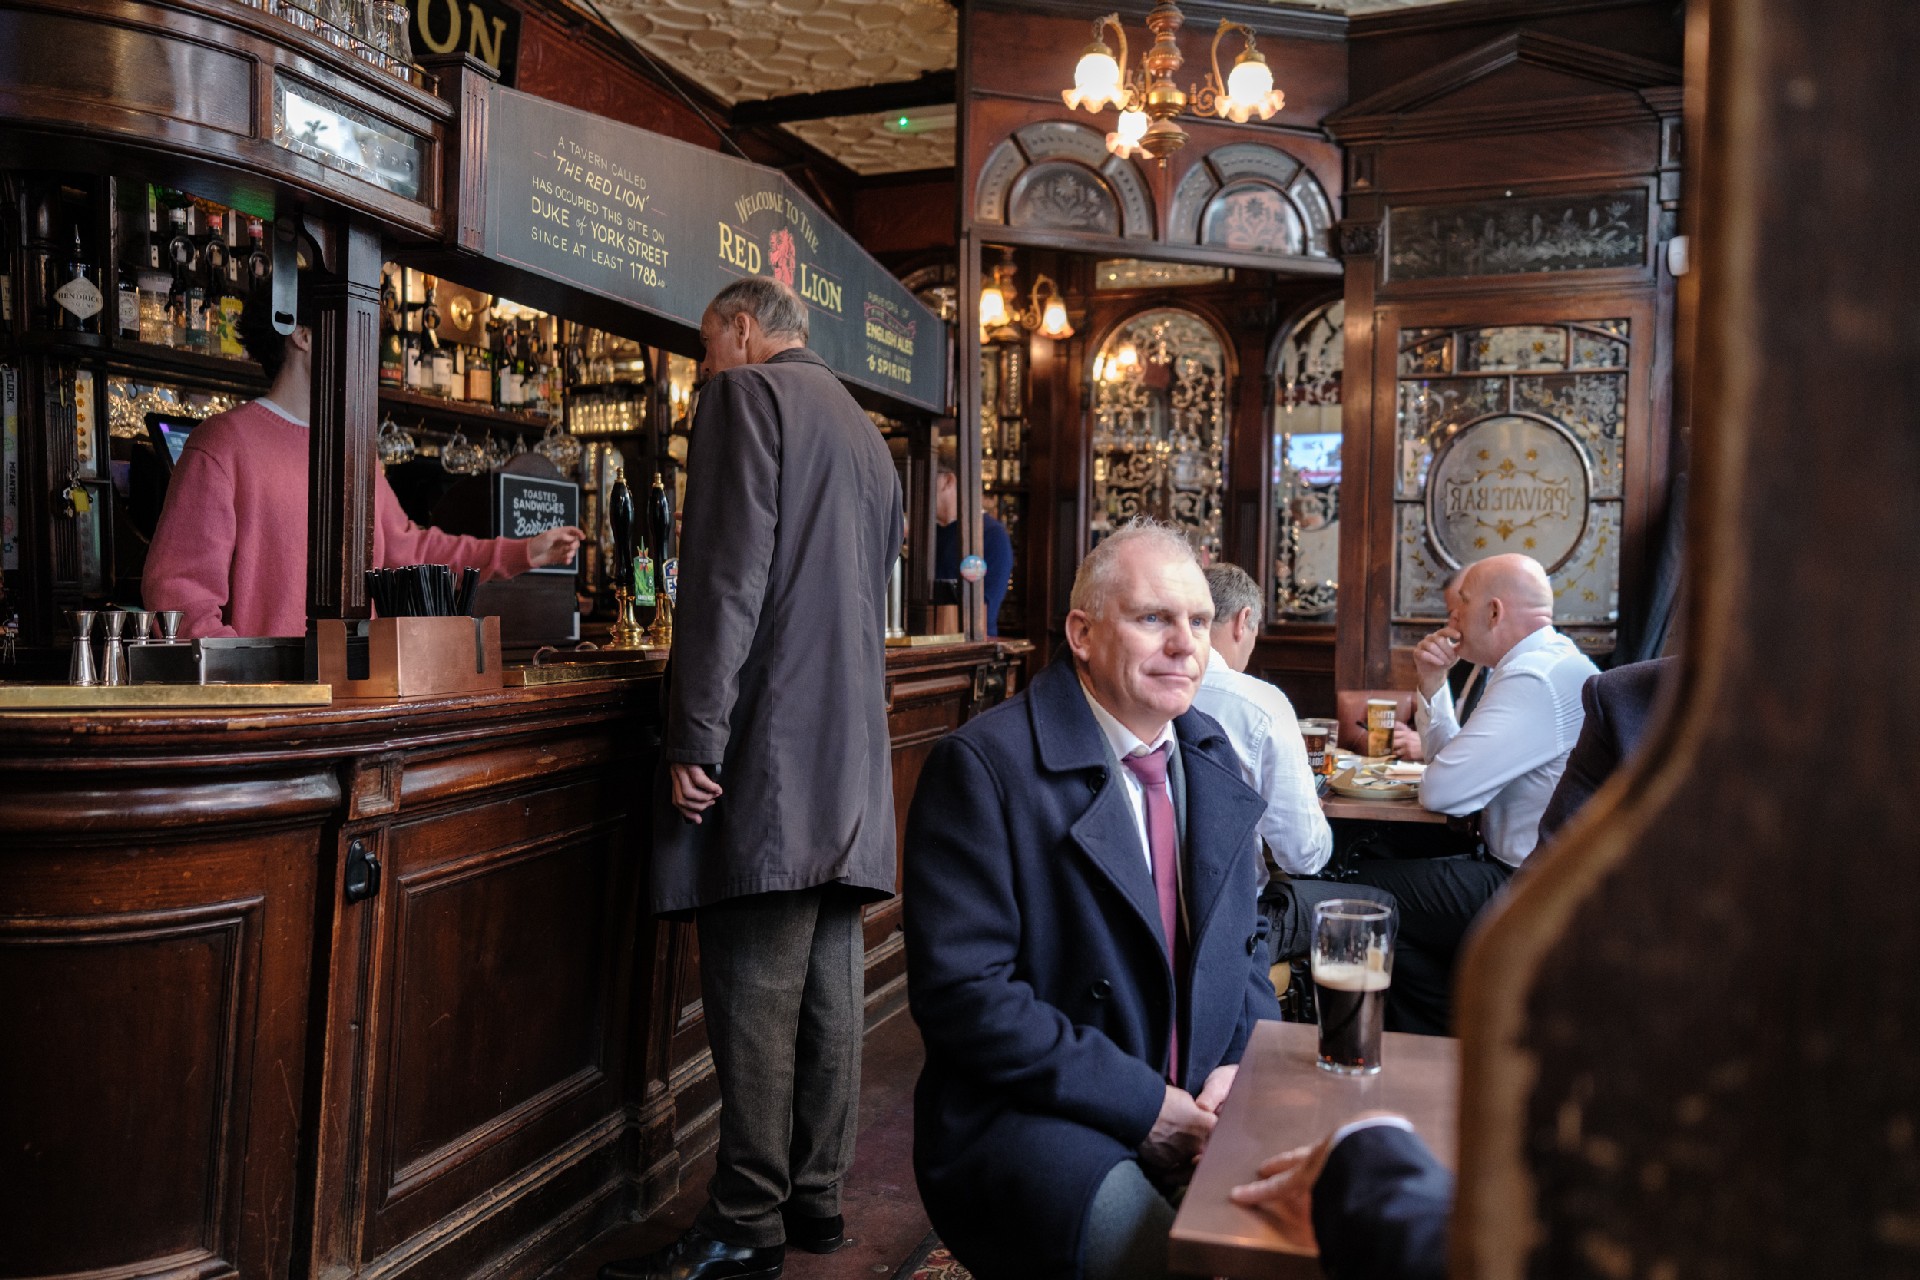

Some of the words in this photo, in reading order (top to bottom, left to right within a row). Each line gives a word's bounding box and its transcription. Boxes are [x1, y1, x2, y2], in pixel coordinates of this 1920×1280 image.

[558, 136, 565, 149] A
[569, 141, 608, 170] TAVERN
[611, 162, 647, 190] CALLED
[585, 171, 612, 196] RED
[531, 195, 570, 228] DUKE
[575, 215, 588, 236] of
[591, 220, 625, 252] YORK
[627, 236, 669, 268] STREET
[532, 175, 553, 195] HAS
[555, 185, 599, 216] OCCUPIED
[601, 205, 623, 226] THIS
[628, 217, 648, 238] SITE
[652, 228, 665, 245] ON
[735, 191, 783, 224] WELCOME
[785, 198, 799, 226] TO
[800, 211, 819, 255] THE
[531, 226, 568, 252] SINCE
[572, 242, 587, 259] AT
[591, 249, 624, 272] LEAST
[718, 221, 761, 275] RED
[801, 262, 842, 313] LION
[866, 320, 897, 350] ENGLISH
[897, 336, 914, 355] ALES
[877, 357, 911, 385] SPIRITS
[513, 497, 565, 515] SANDWICHES
[523, 488, 558, 503] TOASTED
